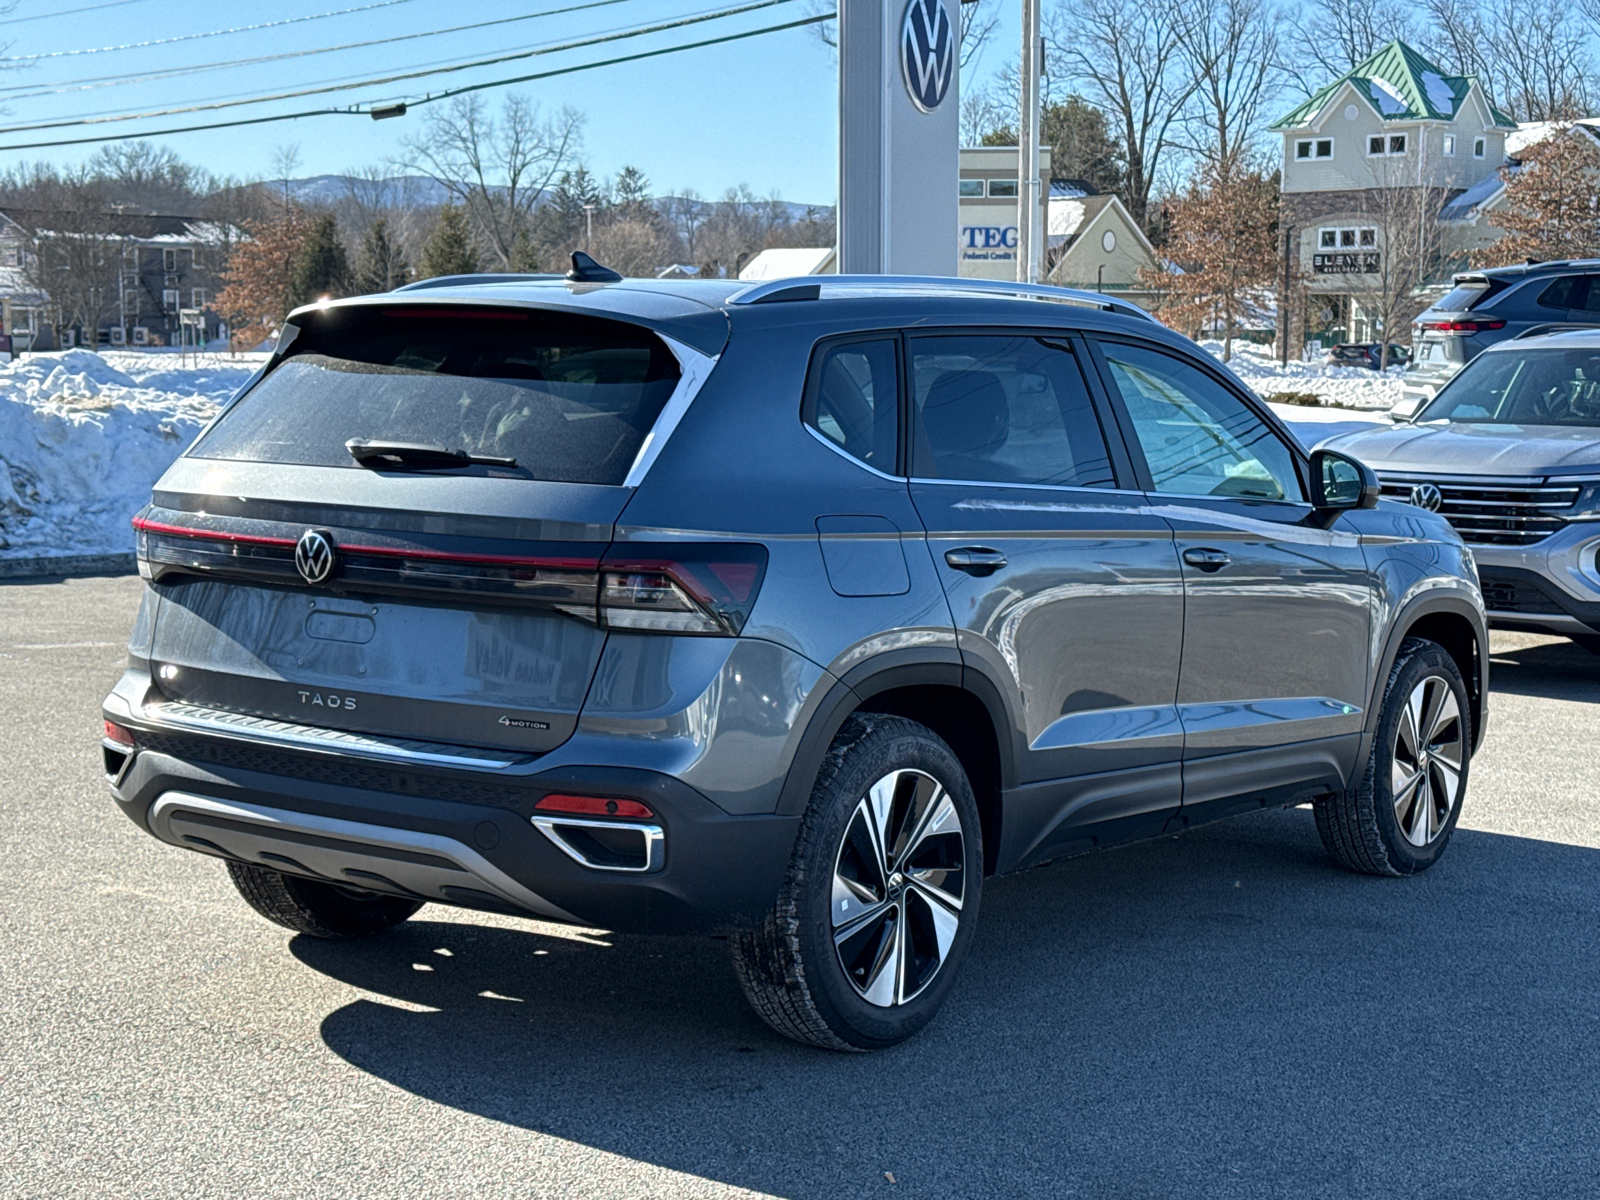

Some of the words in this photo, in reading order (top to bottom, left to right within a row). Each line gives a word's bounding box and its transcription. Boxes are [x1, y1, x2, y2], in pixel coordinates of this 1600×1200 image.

[962, 226, 1018, 248] TEG
[963, 251, 988, 260] Federal
[990, 251, 1012, 260] Credit
[298, 690, 357, 710] TAOS
[498, 715, 547, 729] 4MOTION
